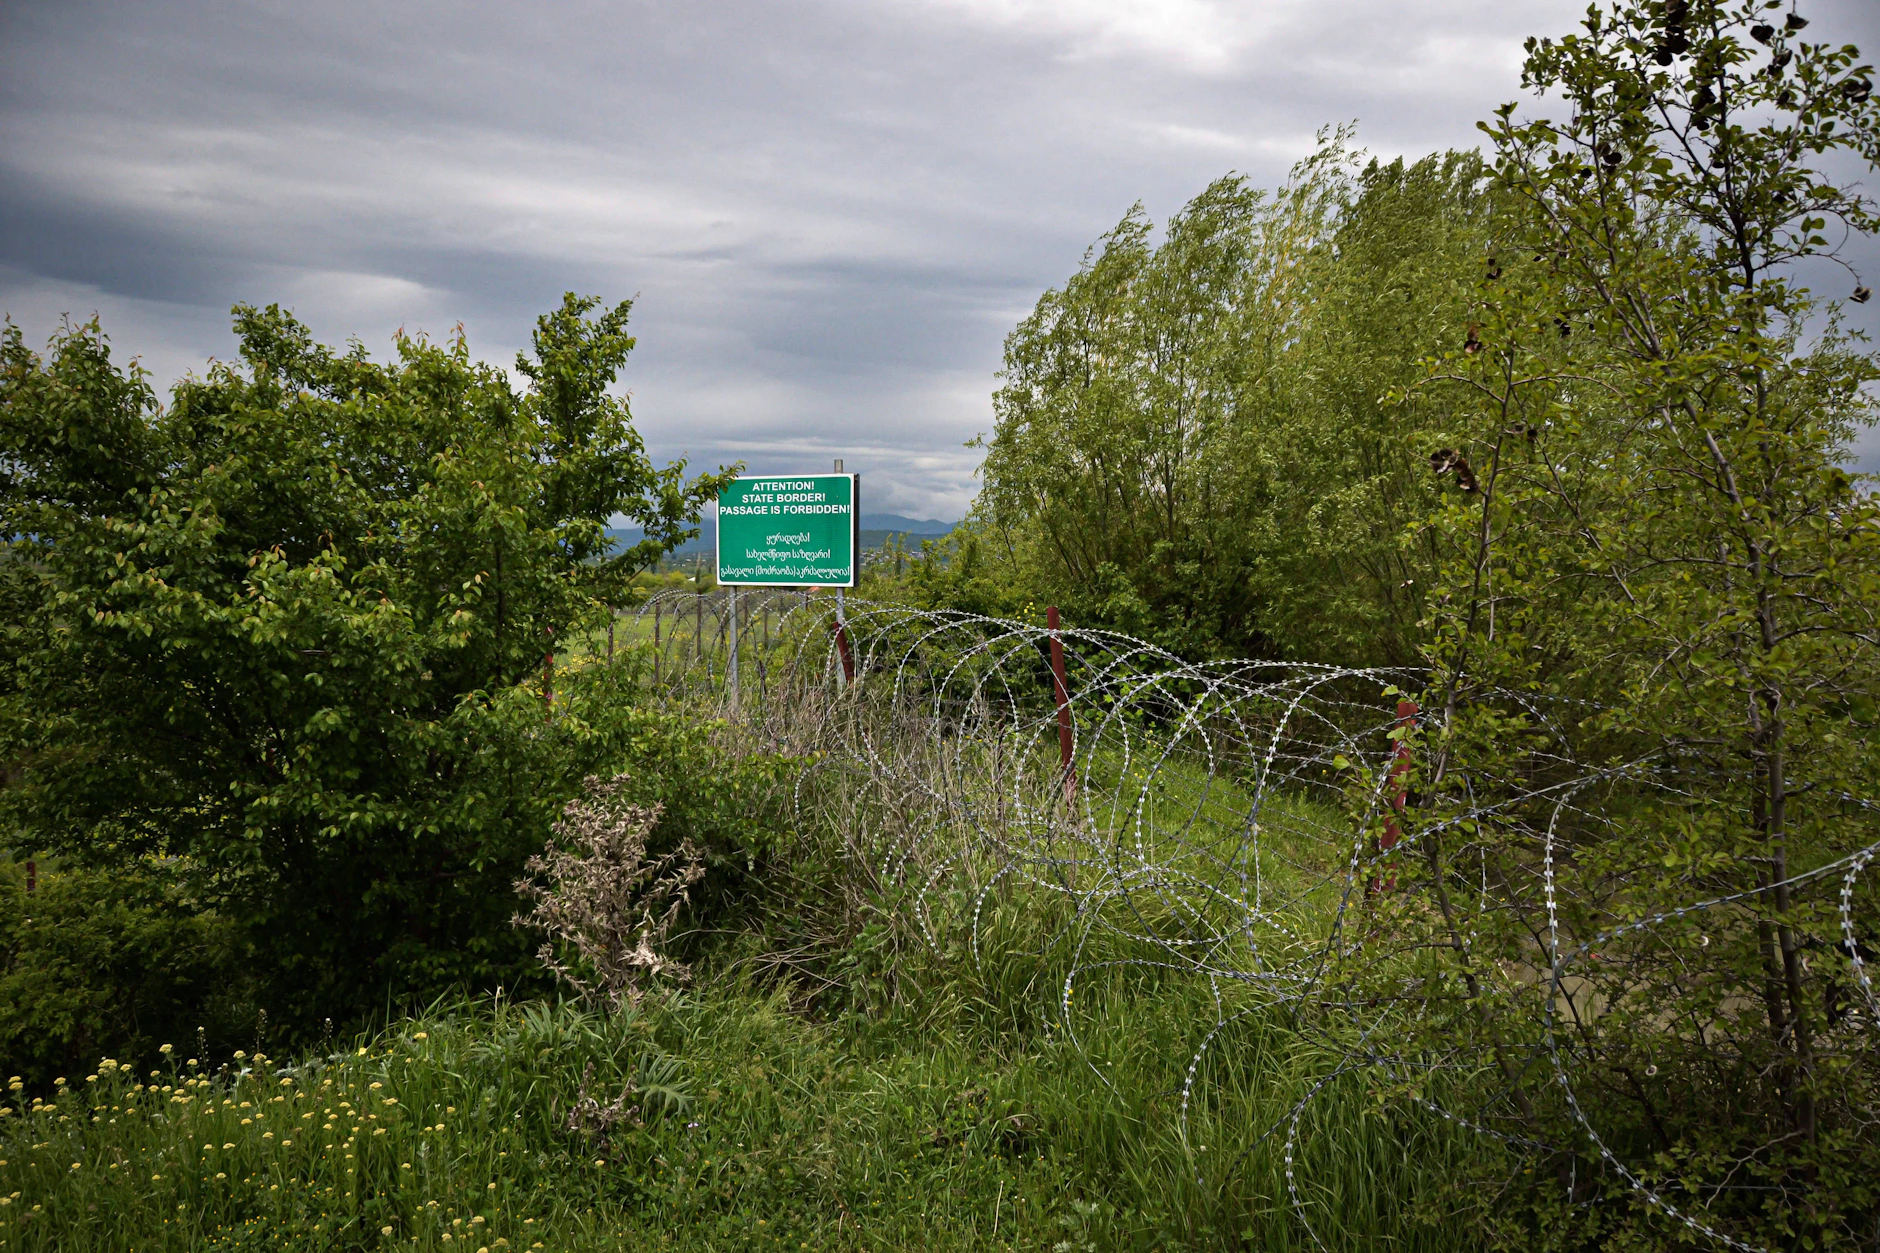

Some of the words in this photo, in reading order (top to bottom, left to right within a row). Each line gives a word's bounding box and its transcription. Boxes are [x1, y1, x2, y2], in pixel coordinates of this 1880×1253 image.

[752, 481, 815, 491] ATTENTION!
[742, 494, 774, 503] STATE
[777, 493, 826, 503] BORDER!
[720, 506, 769, 515] PASSAGE
[771, 505, 781, 515] IS
[784, 504, 851, 514] FORBIDDEN!
